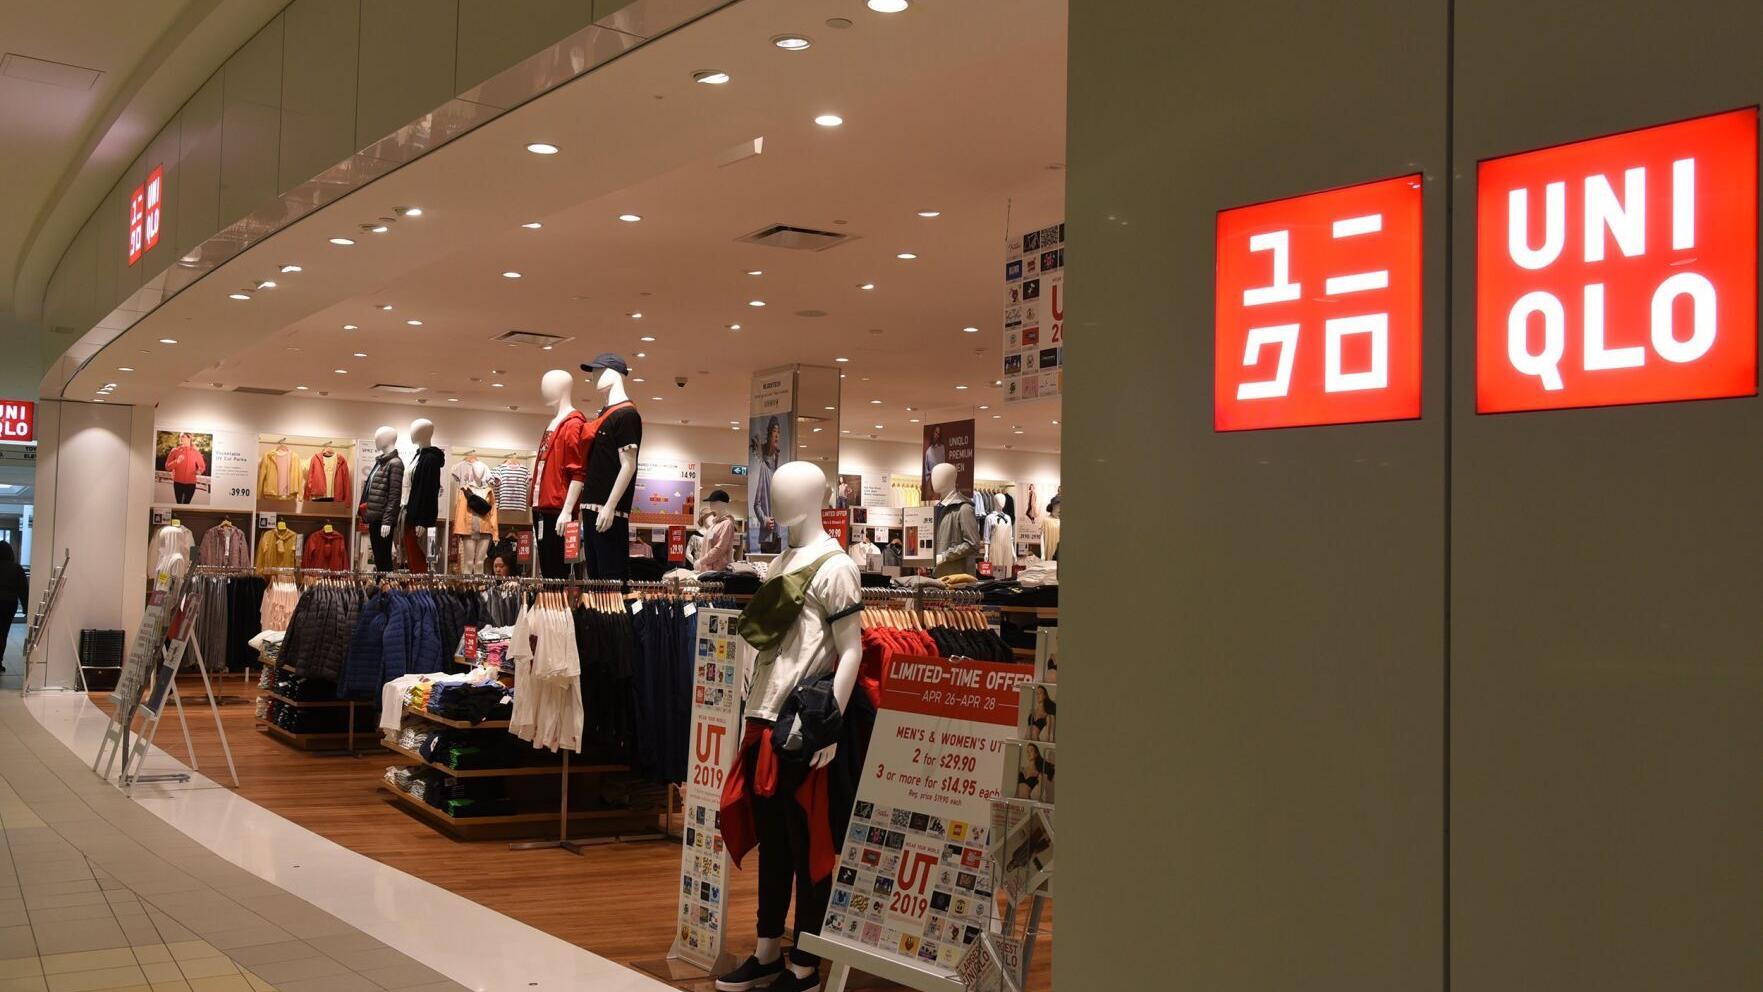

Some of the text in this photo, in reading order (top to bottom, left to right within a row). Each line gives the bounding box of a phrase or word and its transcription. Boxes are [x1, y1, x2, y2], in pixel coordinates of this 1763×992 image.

[147, 176, 160, 209] UNI
[146, 208, 160, 244] QLO
[1507, 158, 1695, 270] UNI
[1242, 213, 1389, 306] ユニ
[1506, 272, 1716, 391] QLO
[1236, 312, 1389, 400] クロ
[948, 448, 973, 460] PREMIUM
[949, 435, 969, 447] UNIQLO
[889, 661, 983, 689] LIMITED-TIME
[921, 690, 942, 704] APR
[983, 697, 997, 711] 28
[695, 722, 727, 766] UT
[896, 726, 925, 742] MEN'S
[928, 731, 936, 743] &
[941, 732, 986, 751] WOMEN'S
[693, 764, 723, 789] 2019
[912, 748, 977, 773] 2 for $29.90
[876, 764, 1000, 799] 3 or more for $14.95 each
[897, 849, 939, 895] UT
[889, 890, 928, 918] 2019
